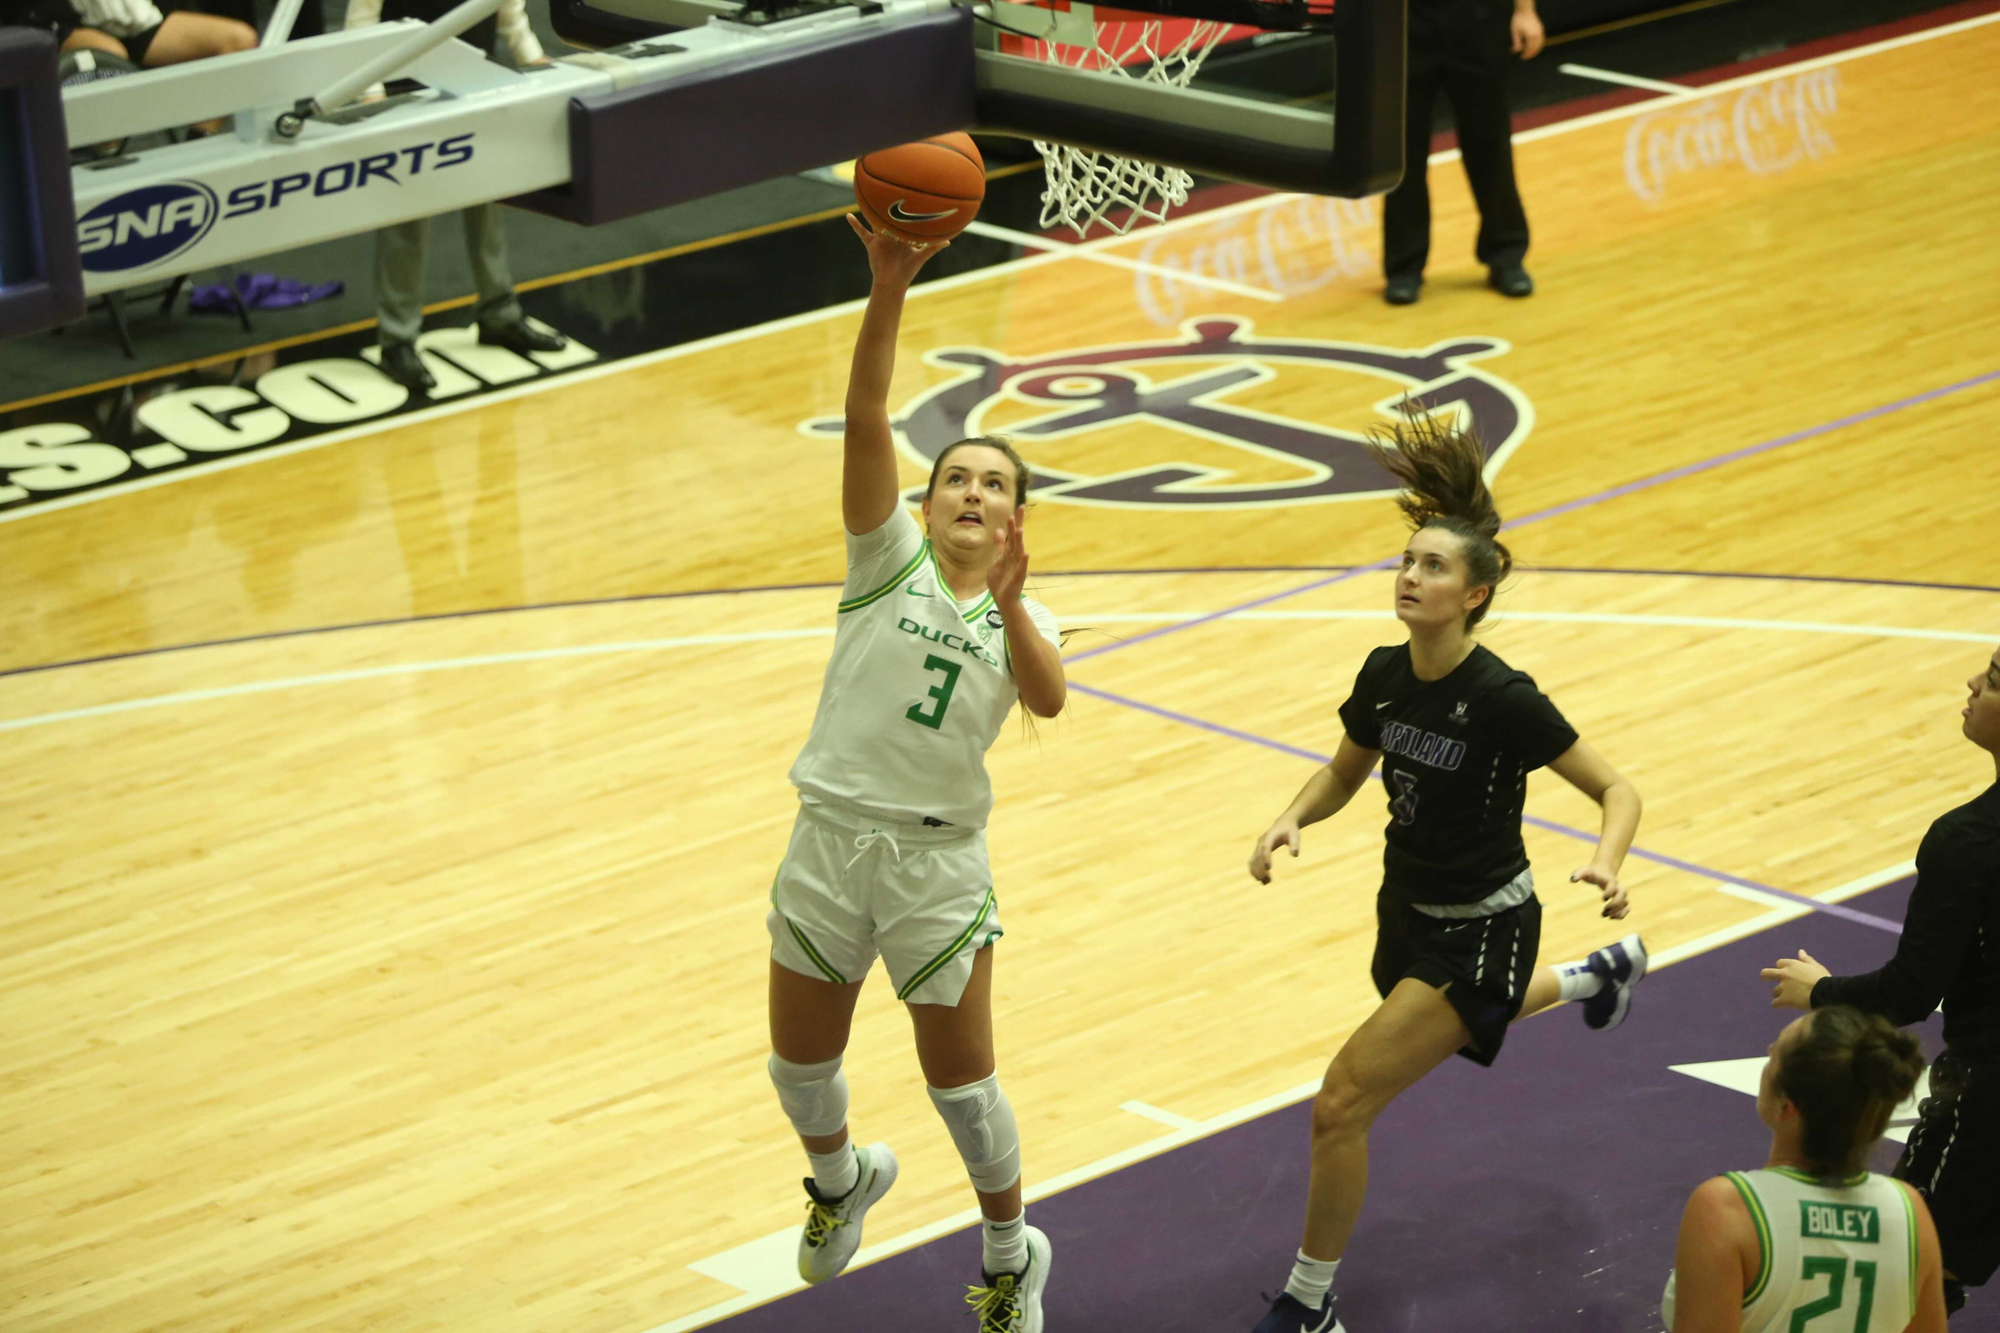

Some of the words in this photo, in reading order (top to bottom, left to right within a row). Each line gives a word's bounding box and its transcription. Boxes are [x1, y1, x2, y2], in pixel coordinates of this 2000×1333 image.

[77, 194, 207, 254] SNA
[222, 133, 475, 219] SPORTS
[898, 617, 998, 667] DUCKS
[905, 653, 962, 730] 3
[1808, 1206, 1872, 1238] BOLEY
[1788, 1256, 1877, 1333] 21
